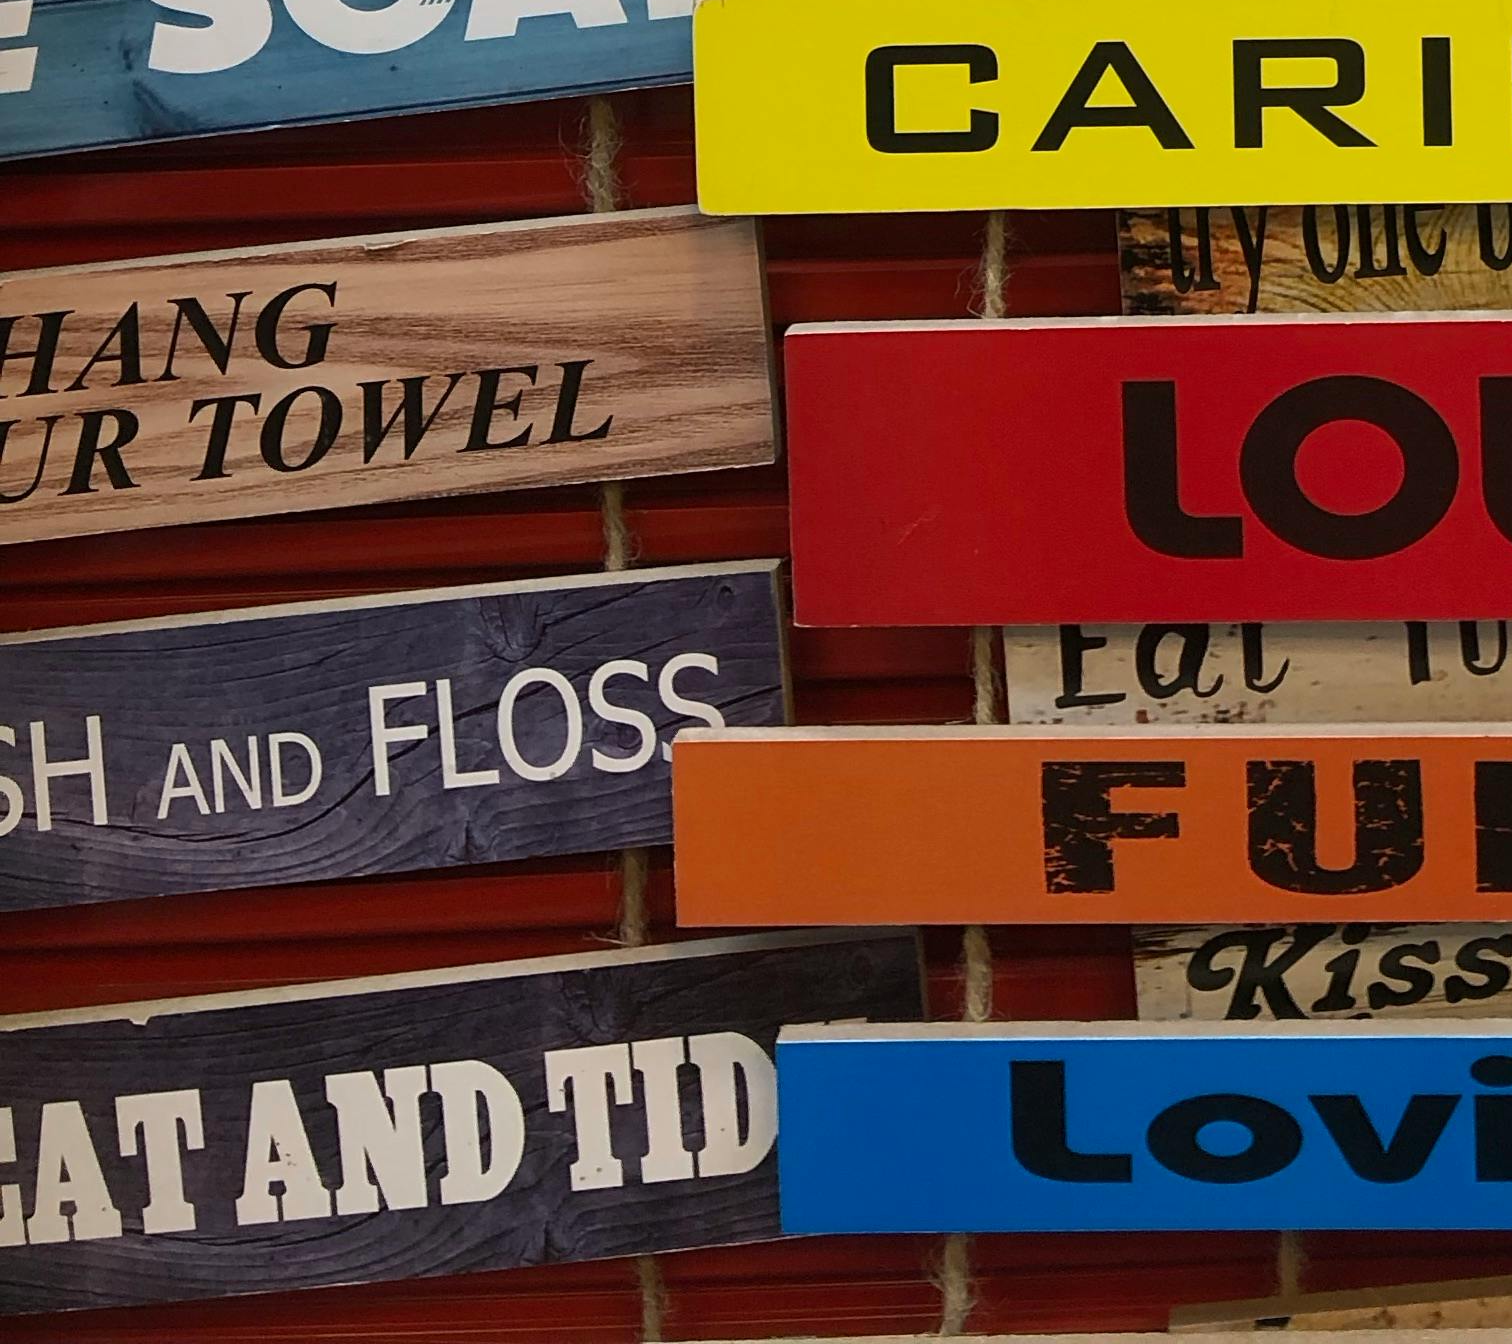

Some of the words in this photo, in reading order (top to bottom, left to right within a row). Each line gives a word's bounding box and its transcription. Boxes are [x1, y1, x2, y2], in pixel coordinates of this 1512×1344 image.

[0, 281, 337, 399] HANG
[0, 408, 141, 504] UR
[188, 359, 614, 482] TOWEL
[157, 732, 322, 819] AND
[368, 653, 727, 796] FLOSS
[236, 1059, 525, 1225] AND
[544, 1031, 778, 1191] TID
